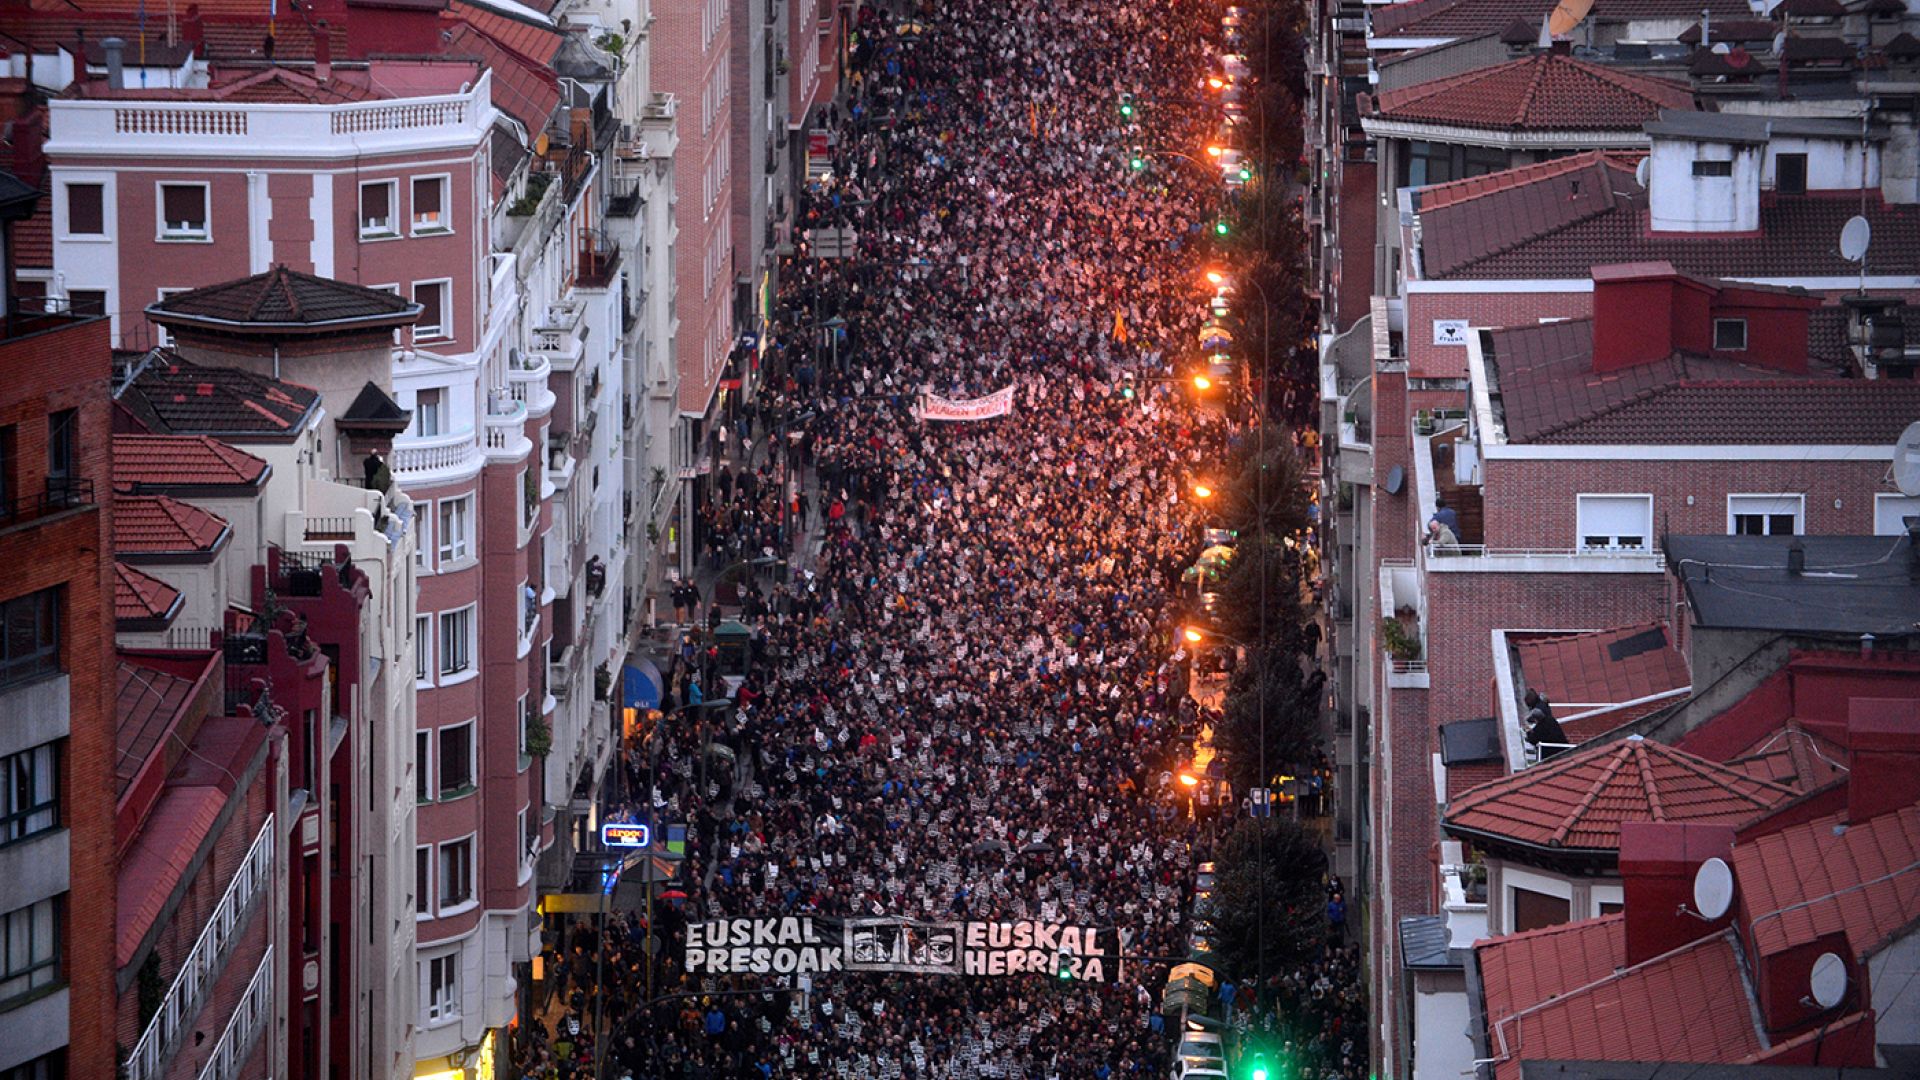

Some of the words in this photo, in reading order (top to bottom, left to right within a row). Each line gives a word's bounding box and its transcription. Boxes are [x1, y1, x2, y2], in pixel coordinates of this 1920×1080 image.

[686, 917, 820, 947] EUSKAL
[966, 921, 1105, 956] EUSKAL
[685, 947, 843, 973] PRESOAK
[964, 949, 1105, 982] HERRIRA
